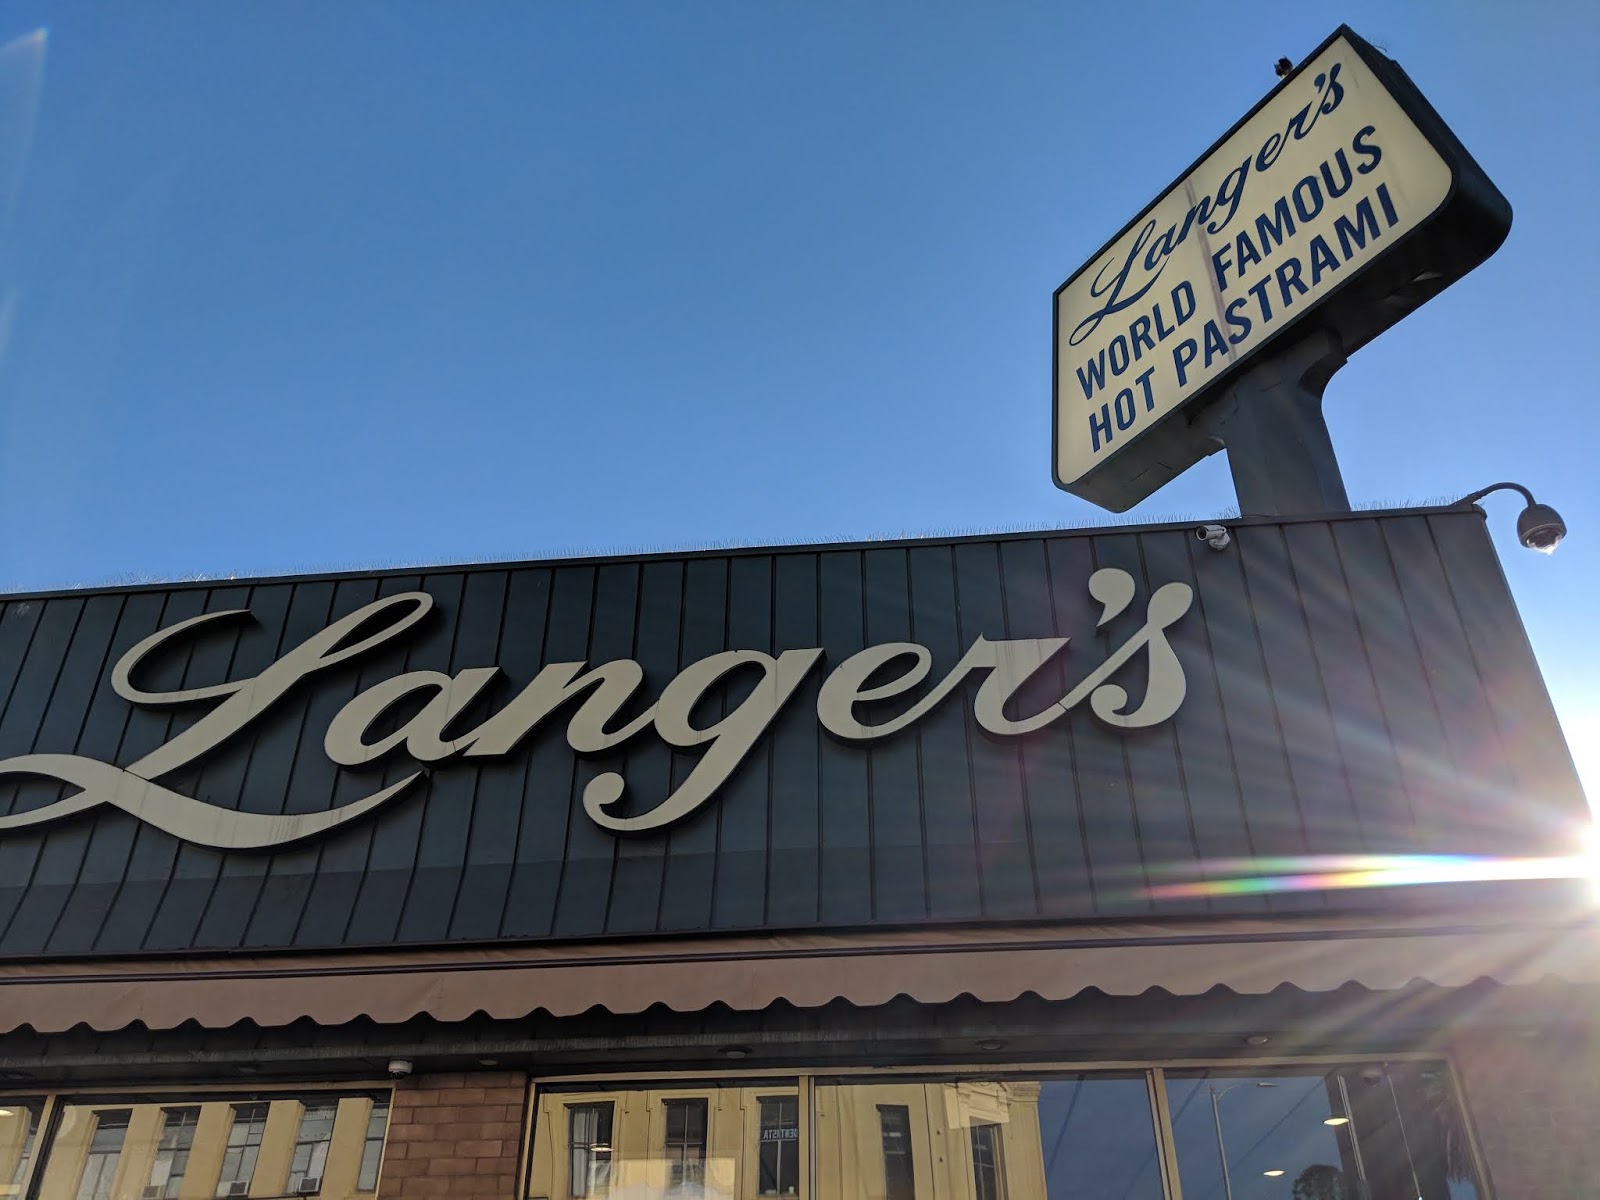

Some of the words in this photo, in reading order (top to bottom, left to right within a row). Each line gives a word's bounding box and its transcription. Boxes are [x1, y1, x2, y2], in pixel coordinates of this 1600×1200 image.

[1069, 62, 1345, 347] Langer's
[1076, 279, 1197, 400] WORLD
[1211, 125, 1383, 291] FAMOUS
[1088, 366, 1156, 453] HOT
[1172, 182, 1400, 387] PASTRAMI
[0, 568, 1194, 849] Langer's
